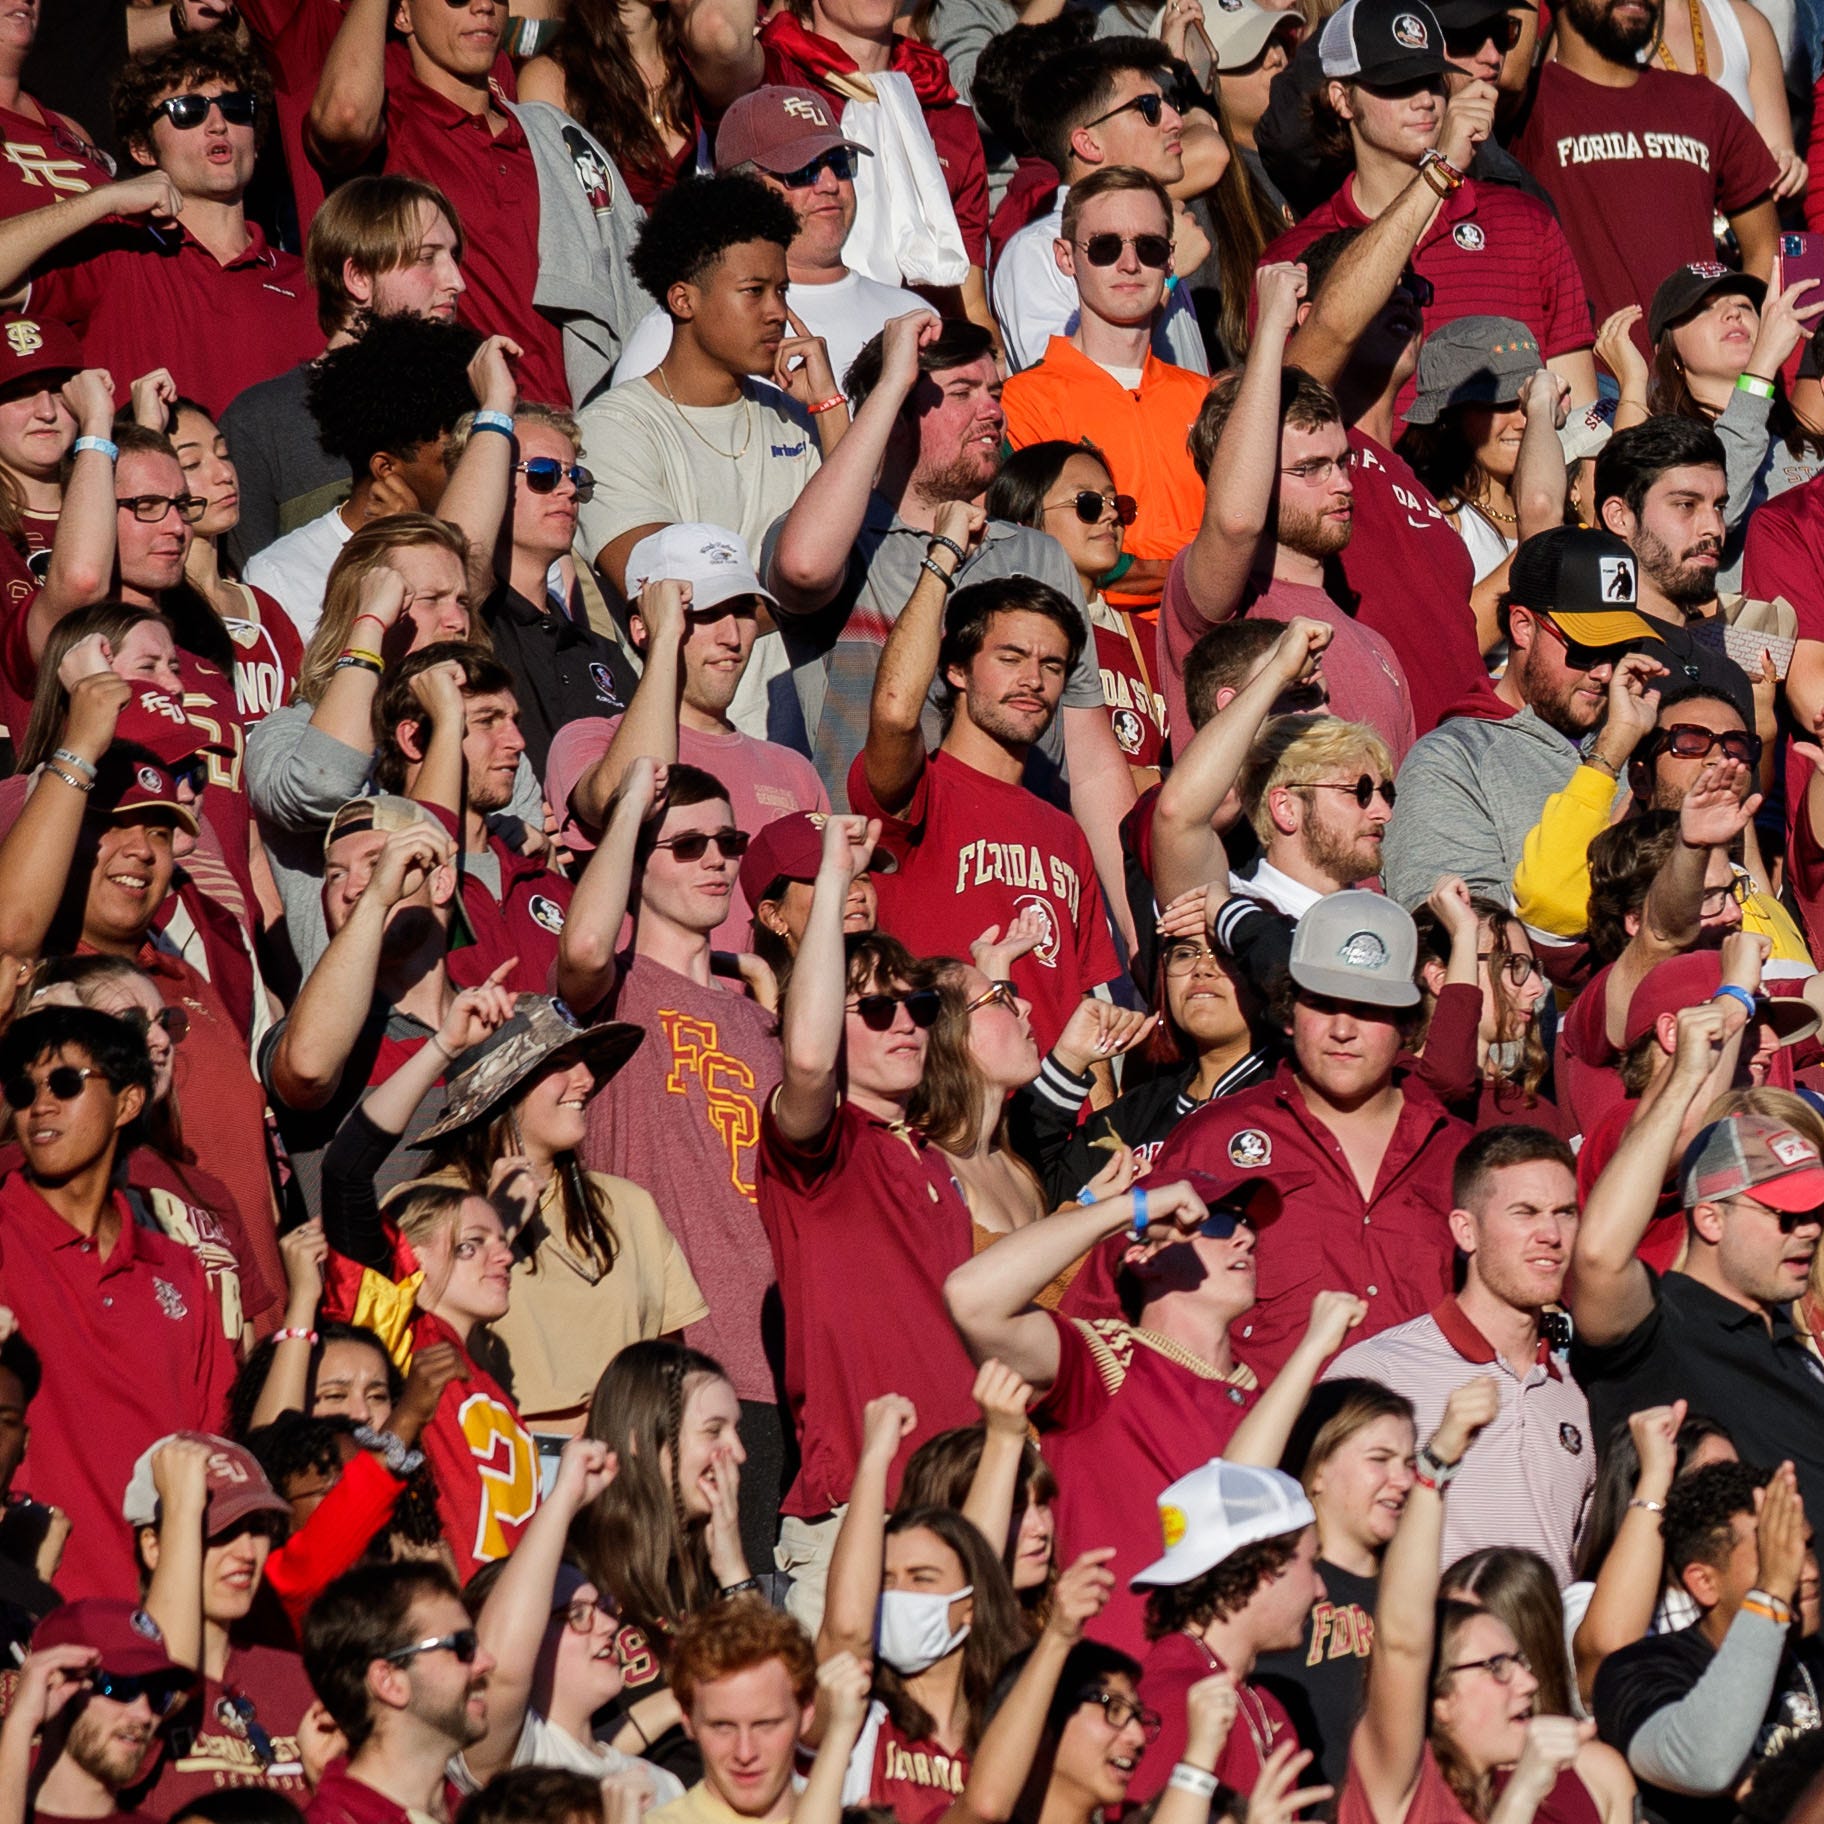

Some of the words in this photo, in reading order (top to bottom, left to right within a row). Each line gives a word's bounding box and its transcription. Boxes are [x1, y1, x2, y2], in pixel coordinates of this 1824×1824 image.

[783, 96, 828, 126] FSU
[1556, 134, 1642, 168] FLORIDA
[1646, 135, 1711, 173] STATE
[140, 692, 187, 725] FSU
[207, 1453, 249, 1482] SU
